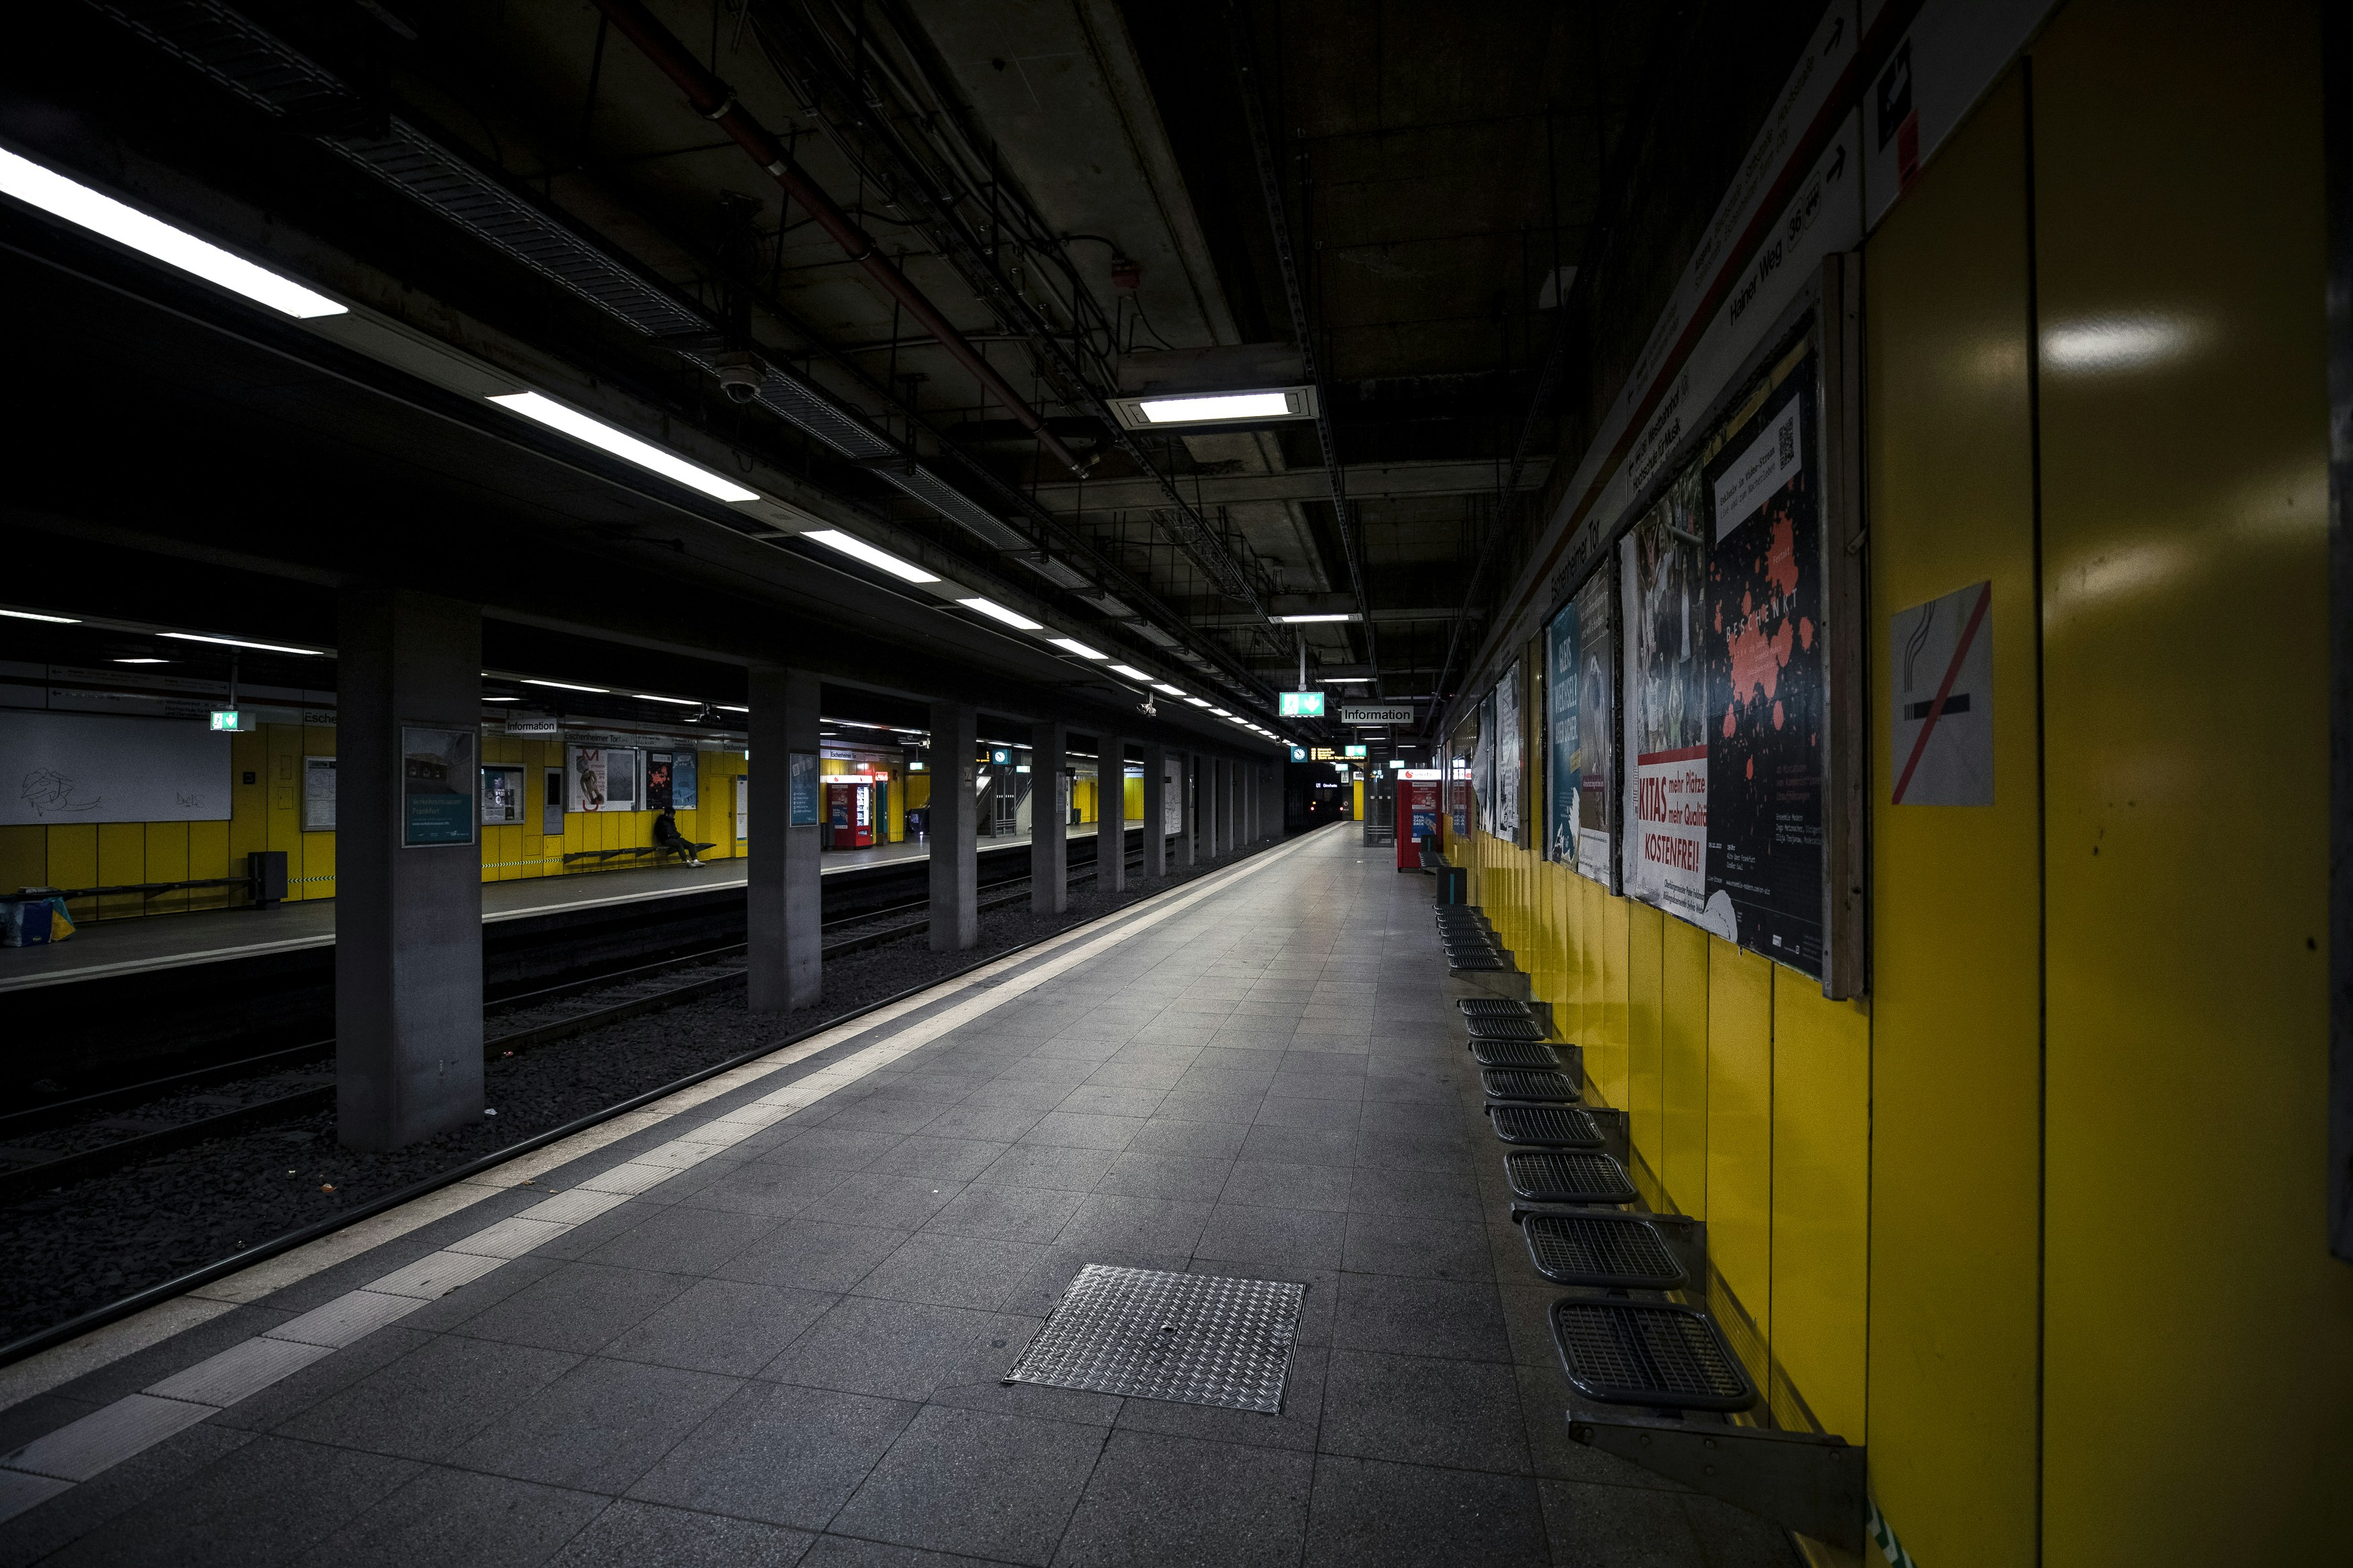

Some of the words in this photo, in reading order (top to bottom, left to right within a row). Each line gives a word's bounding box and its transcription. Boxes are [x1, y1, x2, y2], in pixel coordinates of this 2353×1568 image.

[1730, 274, 1757, 327] Hainer
[1759, 239, 1782, 283] Weg
[1789, 208, 1802, 242] 36
[1648, 384, 1680, 446] Westbahnhof
[1632, 448, 1659, 494] Hochschule
[1665, 416, 1681, 449] Musik
[1720, 485, 1738, 507] Exklusiv
[1745, 446, 1776, 483] Video-Stream
[1551, 537, 1588, 605] Eschenheimer
[1588, 518, 1601, 554] Tor
[1725, 587, 1798, 643] BESCHENKT
[1554, 672, 1577, 714] WECHSEL?
[507, 721, 555, 731] Information
[1345, 709, 1410, 720] Information
[565, 731, 608, 742] Eschenheimer
[609, 734, 619, 743] Tor
[412, 798, 463, 806] Verkehrsmuseum
[1638, 776, 1667, 823] KITAS
[1669, 770, 1683, 794] mehr
[1685, 769, 1706, 794] Plätze
[1668, 800, 1683, 825] mehr
[1776, 813, 1791, 821] Ensemble
[1792, 813, 1803, 822] Modern
[1645, 832, 1700, 874] KOSTENFREI!
[1741, 854, 1756, 864] Frankfurt
